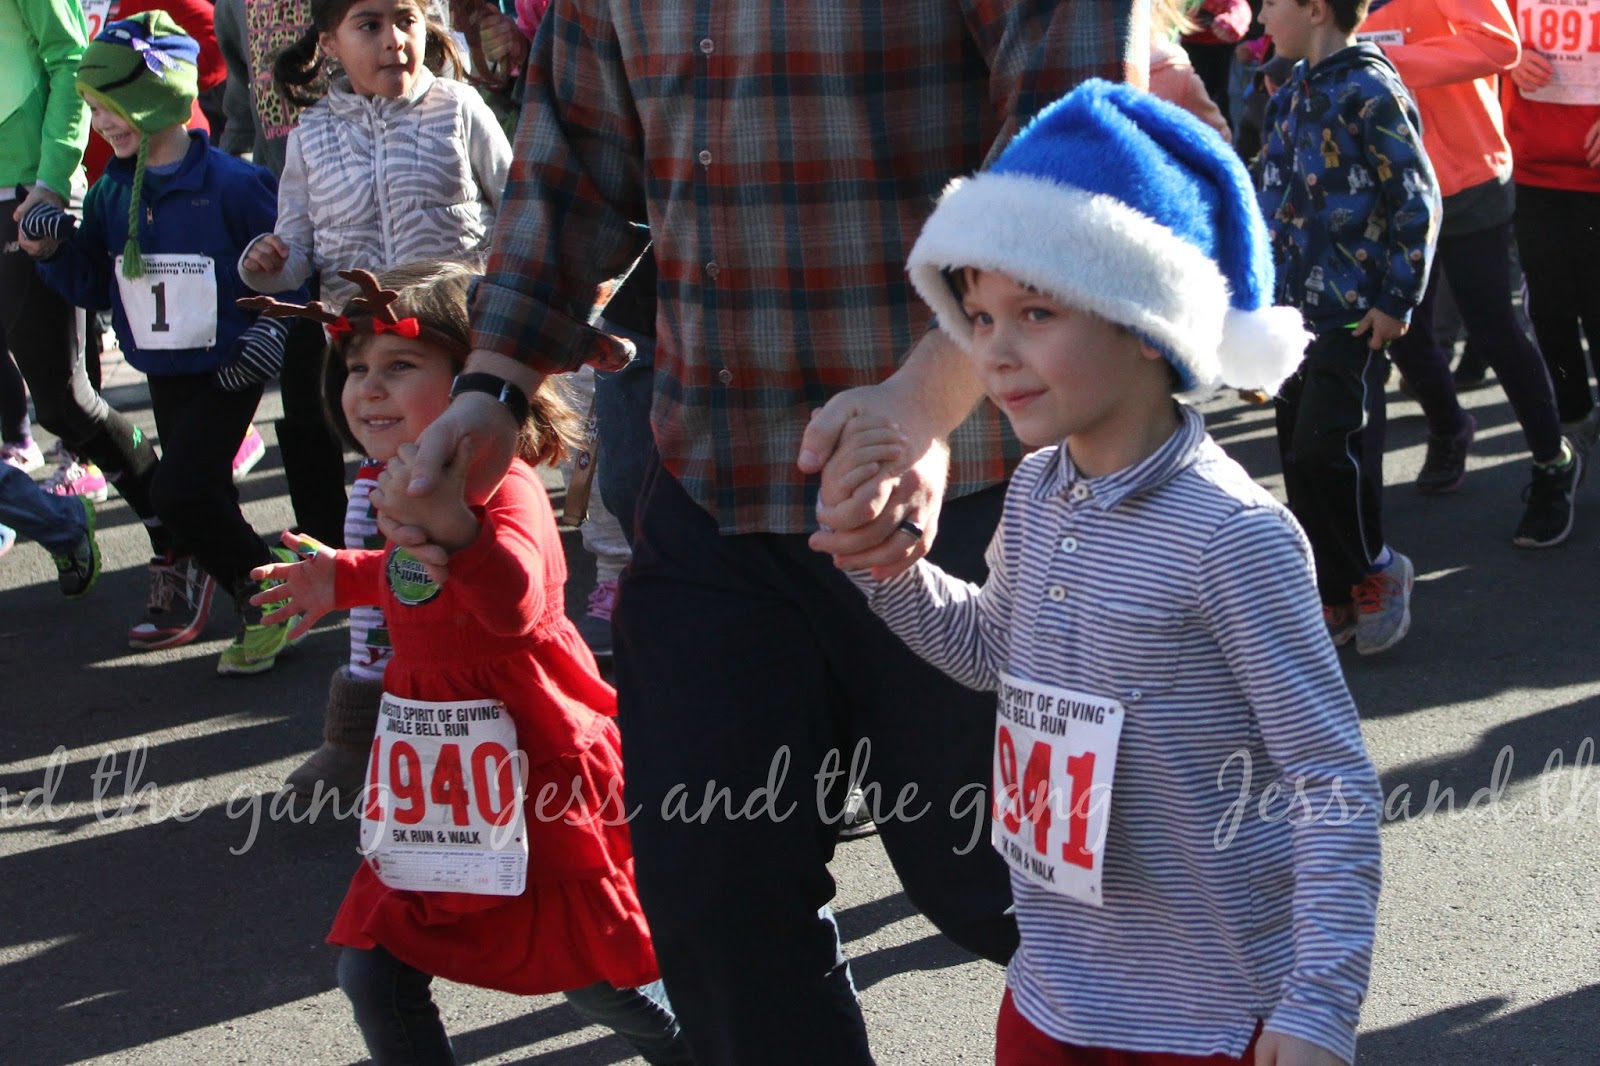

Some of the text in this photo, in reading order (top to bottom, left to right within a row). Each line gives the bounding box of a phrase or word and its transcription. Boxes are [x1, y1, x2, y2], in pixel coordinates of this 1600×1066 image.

[1521, 8, 1600, 53] 1891
[182, 267, 204, 275] Club
[151, 281, 170, 332] 1
[403, 705, 435, 722] SPIRIT
[437, 708, 452, 723] OF
[456, 705, 501, 722] GIVING
[1003, 683, 1034, 709] SPIRIT
[1037, 694, 1053, 713] OF
[1057, 698, 1105, 725] GIVING
[1013, 705, 1037, 730] BELL
[1040, 714, 1067, 736] RUN
[415, 722, 442, 737] BELL
[444, 722, 470, 737] RUN
[364, 735, 516, 827] 1940
[992, 725, 1096, 871] 941
[392, 829, 481, 845] 5K RUN & WALK
